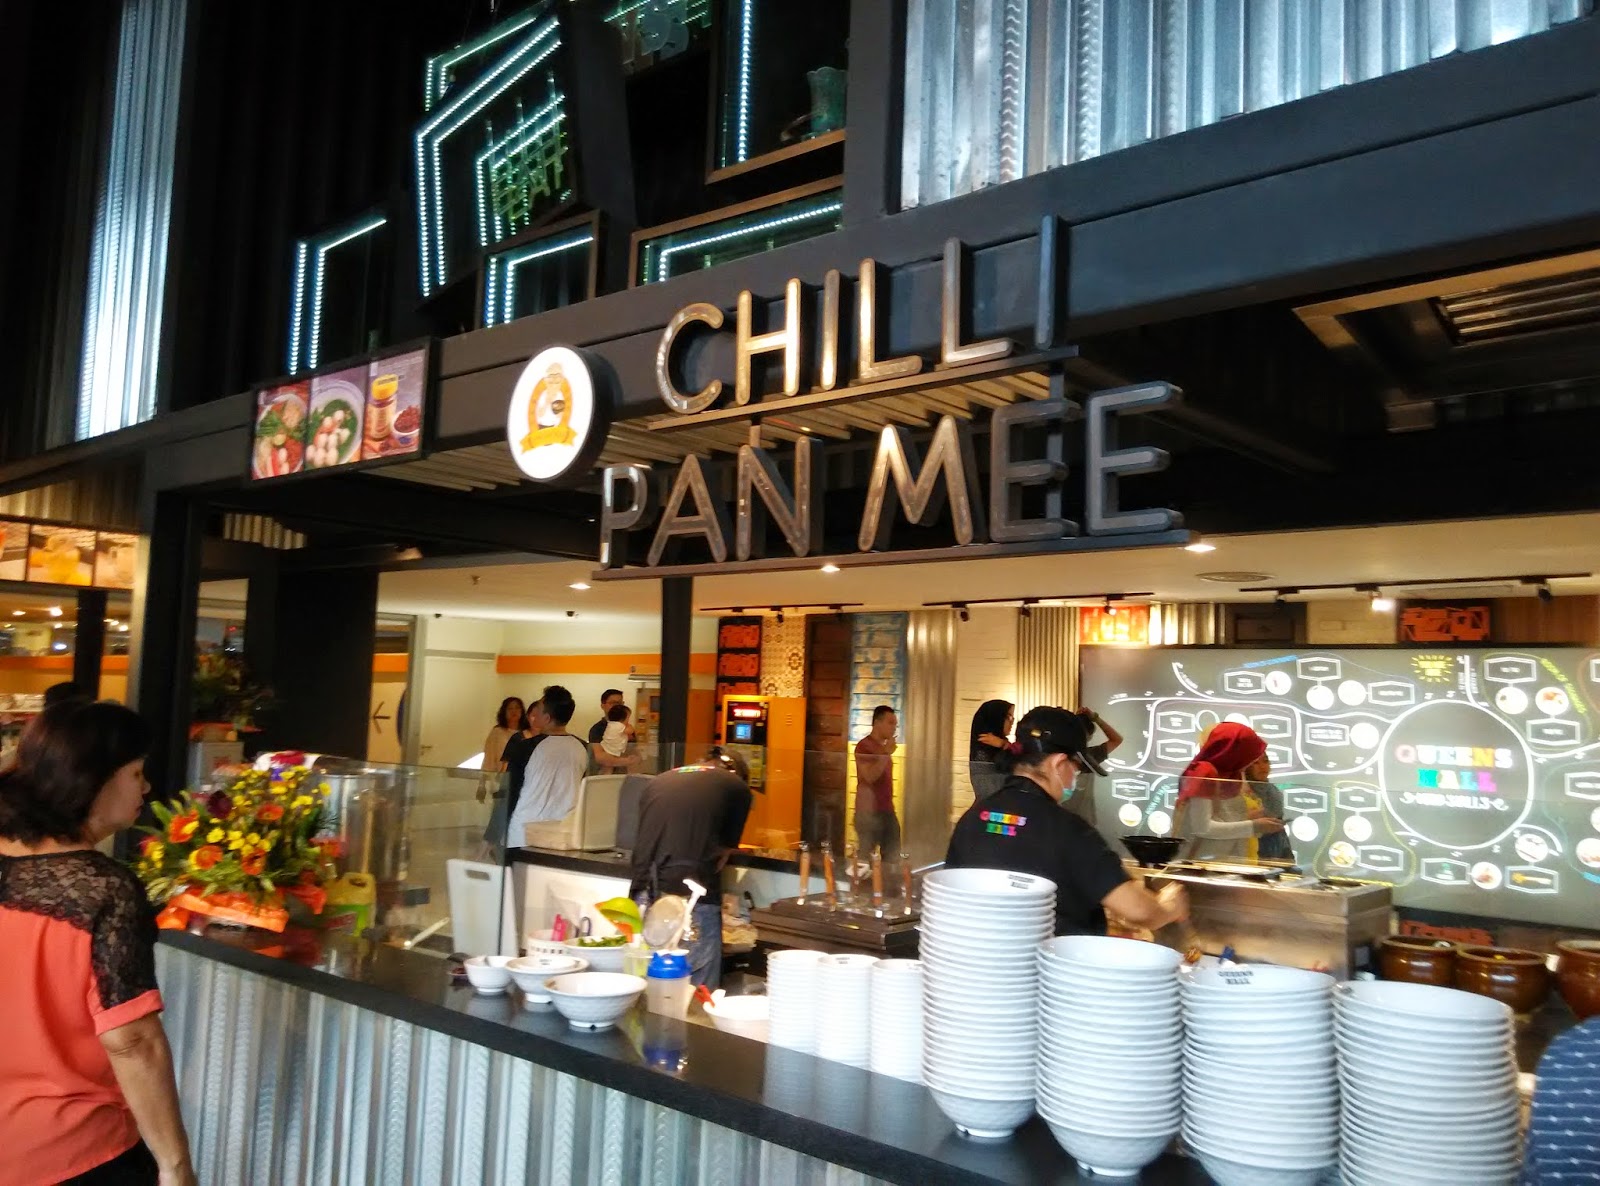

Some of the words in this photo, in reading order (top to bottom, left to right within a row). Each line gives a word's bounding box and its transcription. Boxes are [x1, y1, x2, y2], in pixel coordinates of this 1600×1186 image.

[656, 214, 1066, 415] CHILLI
[599, 436, 817, 571] PAN
[858, 380, 1184, 553] MEE
[1394, 744, 1514, 769] QUEENS
[1417, 768, 1497, 792] HALL
